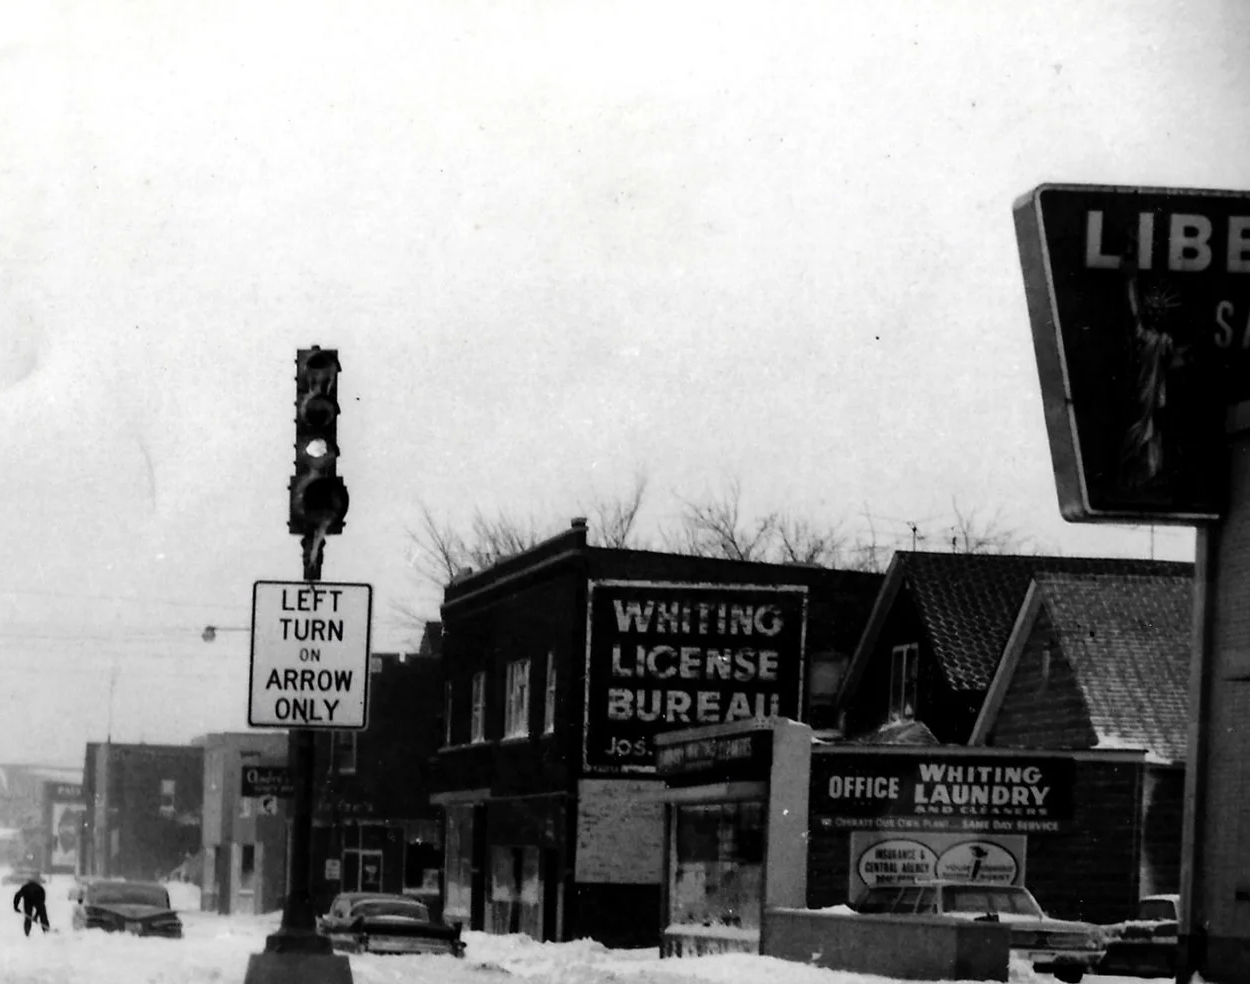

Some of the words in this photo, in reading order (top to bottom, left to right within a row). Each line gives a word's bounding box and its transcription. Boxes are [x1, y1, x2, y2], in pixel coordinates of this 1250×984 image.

[1213, 300, 1250, 349] S
[282, 589, 343, 612] LEFT
[279, 618, 344, 642] TURN
[613, 599, 784, 637] WHITING
[299, 648, 321, 663] ON
[611, 644, 779, 682] LICENSE
[265, 668, 353, 692] ARROW
[275, 697, 340, 722] ONLY
[607, 688, 780, 723] BUREAU
[919, 763, 1043, 784] WHITING
[828, 775, 900, 799] OFFICE
[914, 783, 1051, 806] LAUNDRY
[914, 805, 954, 814] AND
[960, 805, 1048, 816] CLEANERS
[1016, 820, 1060, 831] SERVICE
